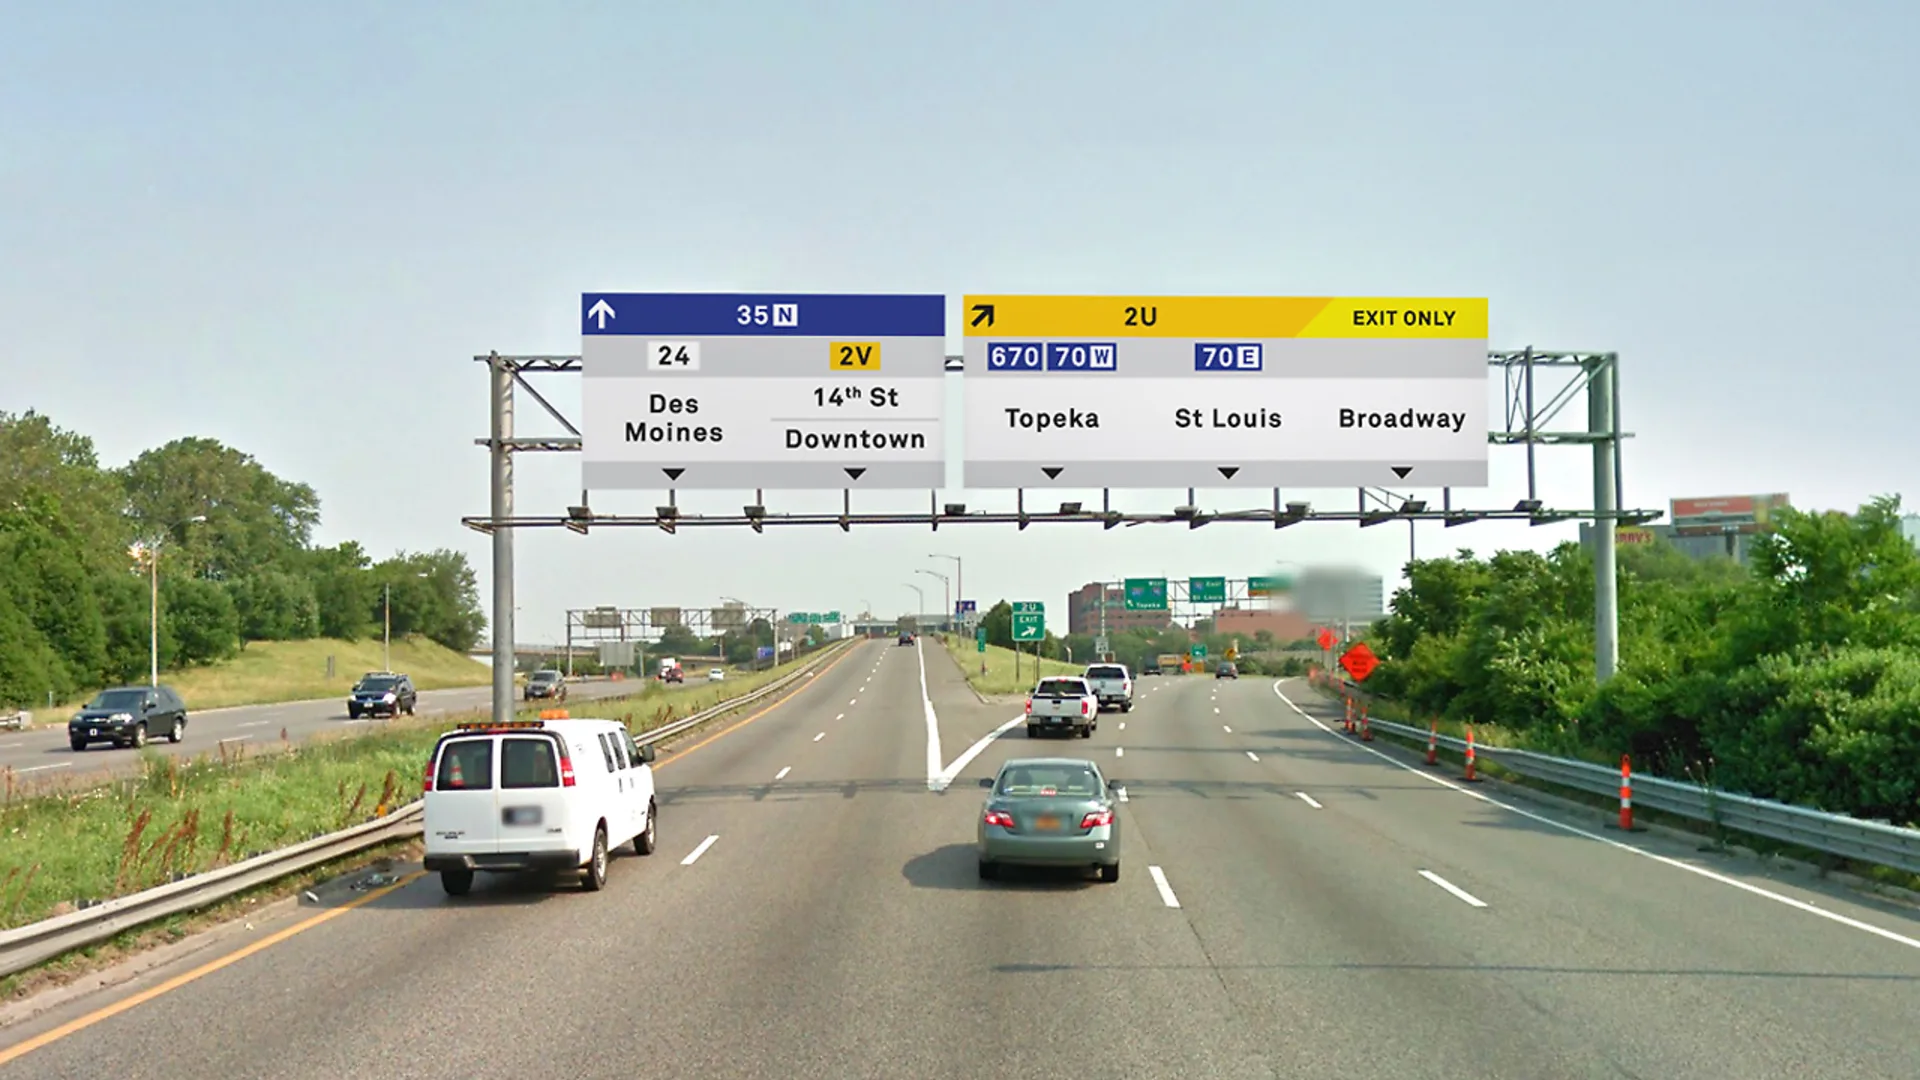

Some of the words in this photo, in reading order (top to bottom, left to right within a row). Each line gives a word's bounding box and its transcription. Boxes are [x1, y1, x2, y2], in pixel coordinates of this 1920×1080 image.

[737, 304, 769, 325] 35
[778, 307, 792, 323] N
[1124, 306, 1157, 327] 2U
[1353, 309, 1398, 326] EXIT
[1403, 309, 1456, 327] ONLY
[658, 345, 690, 366] 24
[839, 345, 873, 366] 2V
[991, 346, 1039, 367] 670
[1055, 346, 1087, 367] 70
[1094, 349, 1110, 365] W
[1202, 346, 1234, 367] 70
[1242, 348, 1255, 365] E
[649, 393, 699, 414] Des
[813, 386, 861, 407] 14th
[869, 386, 899, 407] St
[1004, 407, 1100, 433] Topeka
[1175, 407, 1203, 429] St
[1212, 407, 1282, 429] Louis
[1339, 407, 1466, 433] Broadway
[625, 421, 723, 442] Moines
[785, 428, 925, 449] Downtown
[1020, 602, 1037, 612] 2U
[1019, 615, 1038, 623] EXIT
